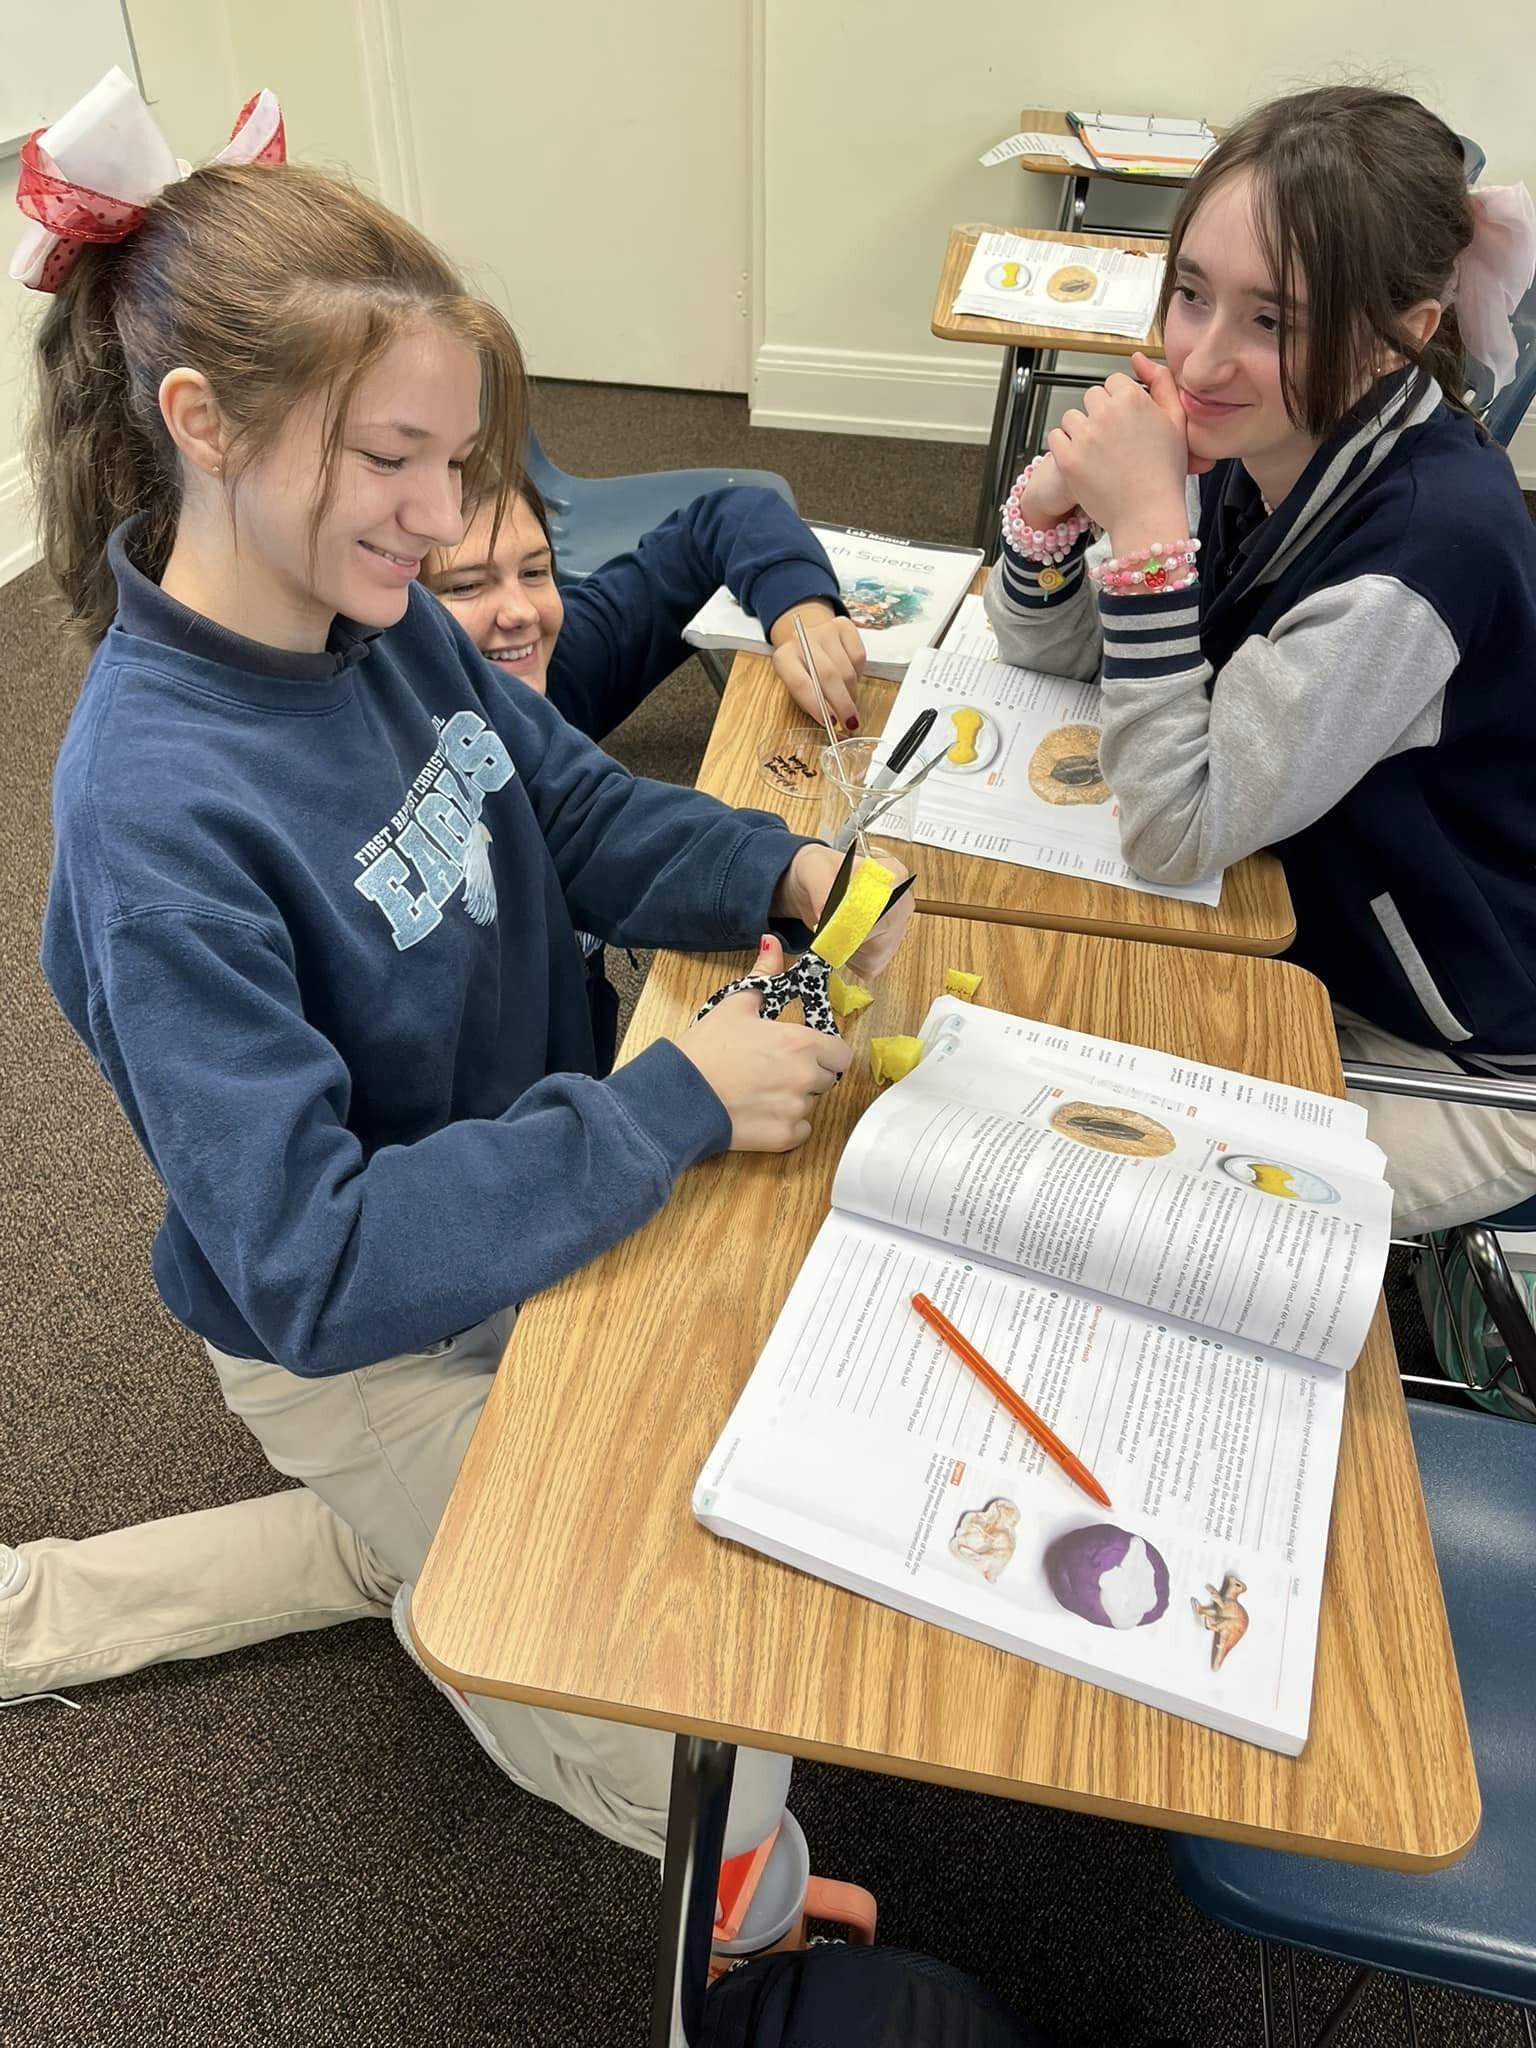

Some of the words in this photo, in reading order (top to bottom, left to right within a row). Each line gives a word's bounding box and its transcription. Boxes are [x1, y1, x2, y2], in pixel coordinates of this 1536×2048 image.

[846, 528, 867, 539] Lab
[868, 533, 911, 546] Manual
[855, 549, 935, 572] Science
[353, 826, 391, 868] FIRST
